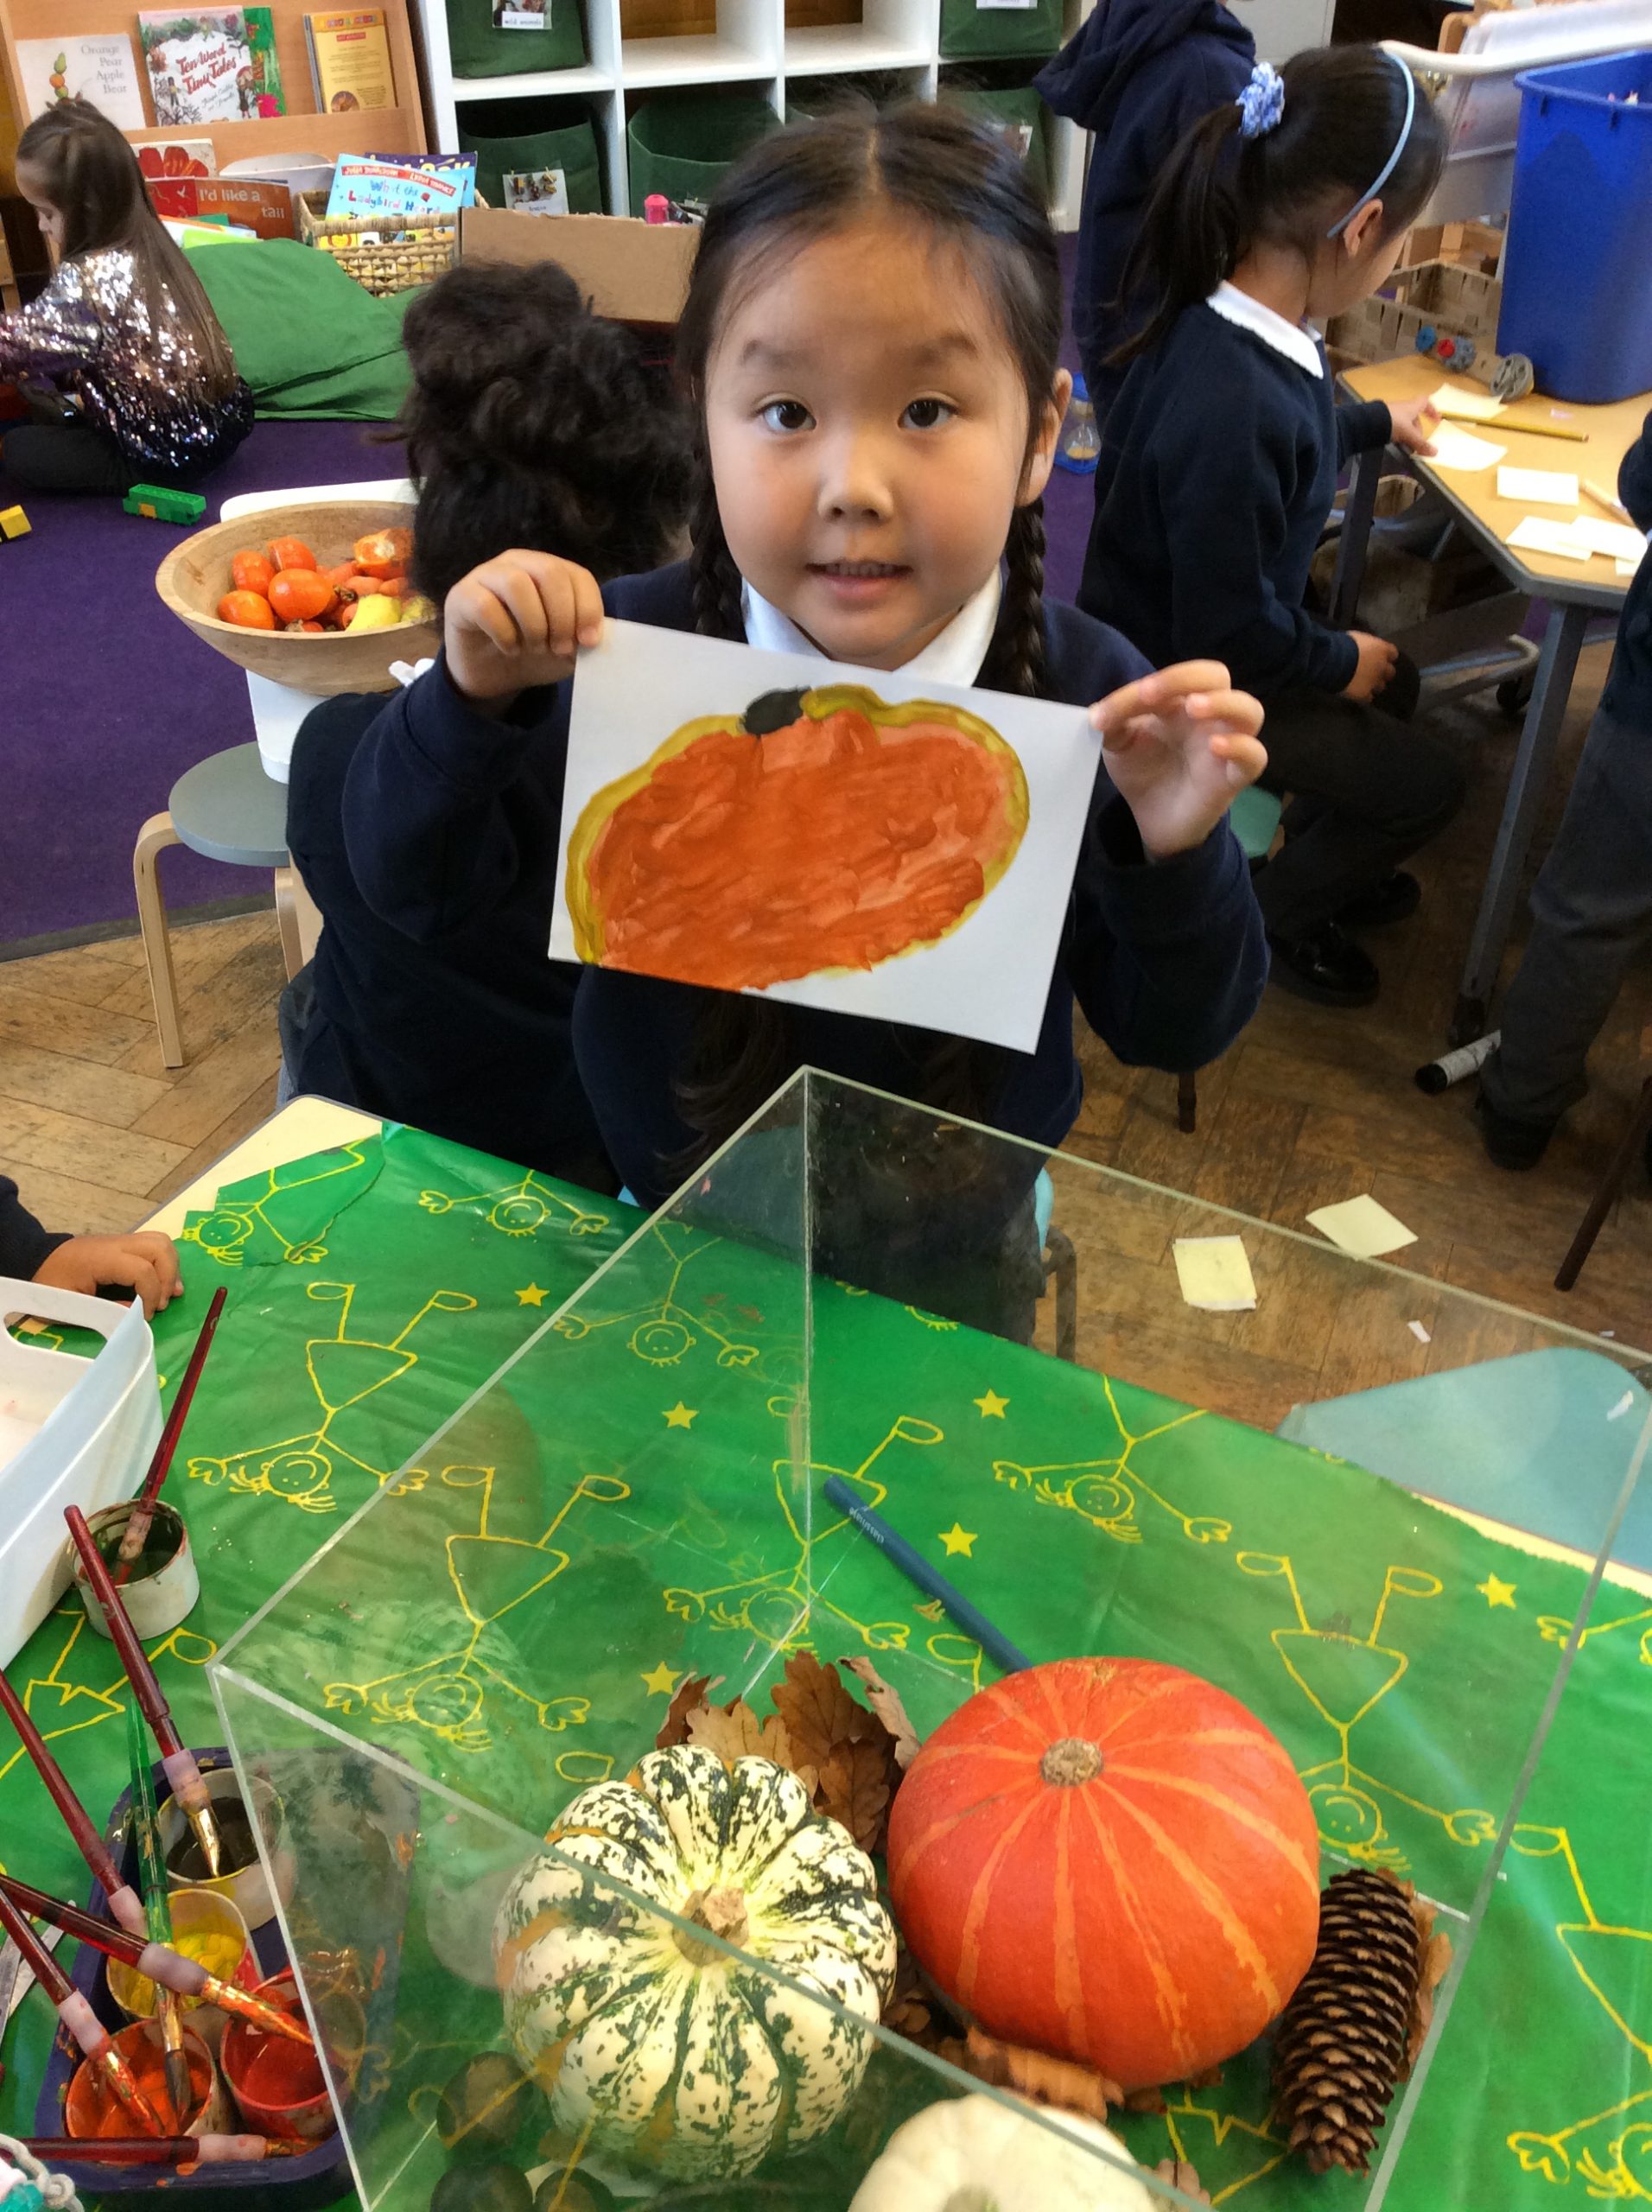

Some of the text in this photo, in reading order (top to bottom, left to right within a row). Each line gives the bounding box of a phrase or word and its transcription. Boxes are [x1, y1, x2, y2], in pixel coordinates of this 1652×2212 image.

[80, 44, 119, 56] Orange
[99, 57, 123, 67] Pear
[96, 69, 124, 82] Apple
[182, 56, 237, 95] Tiny Tales
[103, 84, 127, 94] Bear
[199, 188, 261, 201] I'd like a
[403, 186, 419, 196] the
[348, 189, 402, 209] Ladybird
[261, 207, 285, 219] tail
